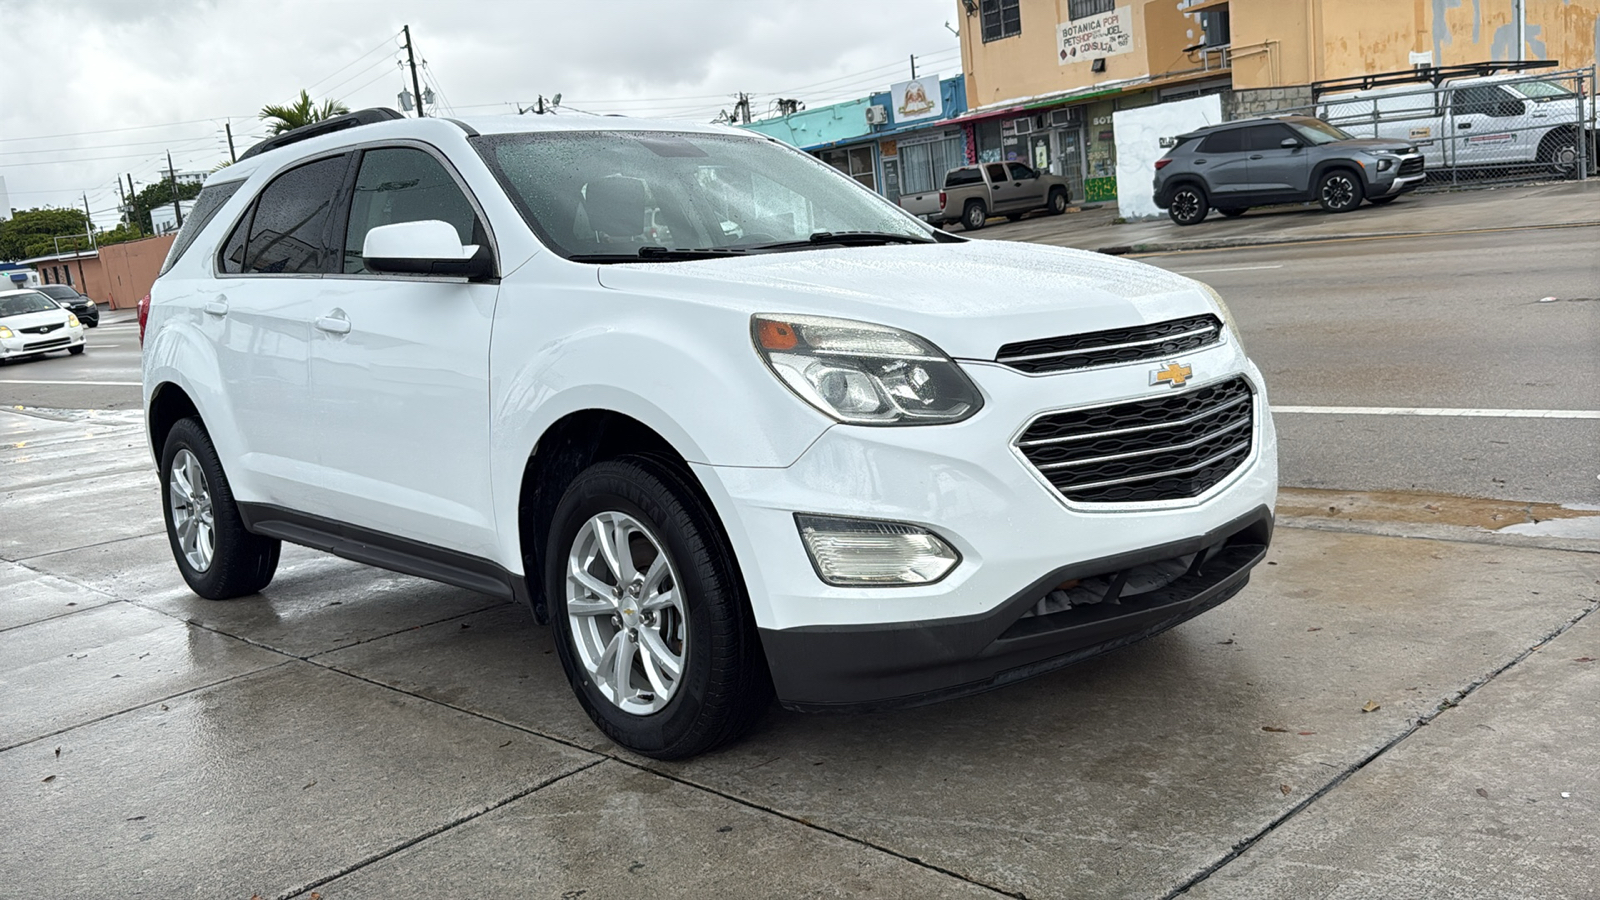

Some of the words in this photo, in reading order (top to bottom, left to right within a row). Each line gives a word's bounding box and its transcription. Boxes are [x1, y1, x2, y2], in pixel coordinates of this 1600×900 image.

[1062, 20, 1101, 38] BOTANICA
[1103, 15, 1119, 27] POPI
[1104, 25, 1122, 36] JOEL
[1093, 116, 1114, 125] BOT
